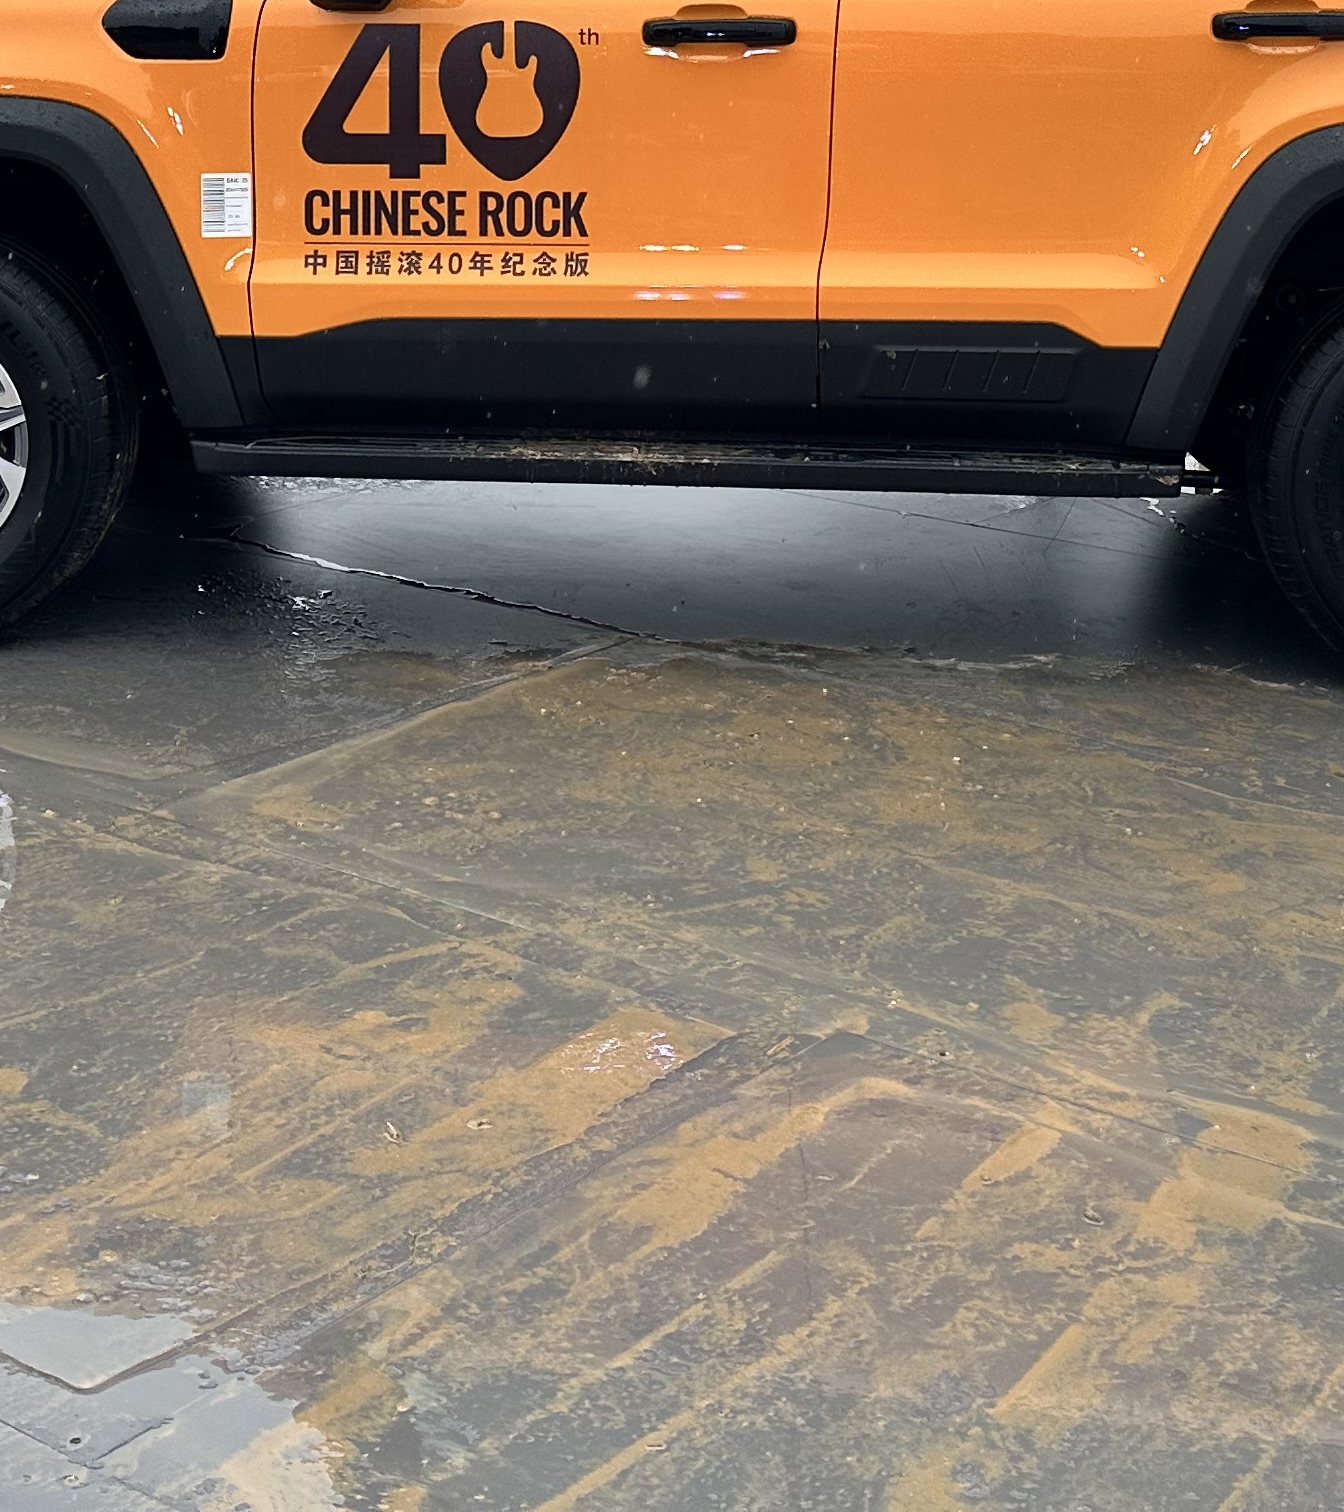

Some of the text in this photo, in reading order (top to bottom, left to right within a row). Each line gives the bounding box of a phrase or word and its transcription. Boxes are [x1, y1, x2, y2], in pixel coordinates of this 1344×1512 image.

[304, 189, 589, 238] CHINESE ROCK
[303, 249, 590, 278] 中国摇滚40年纪念版
